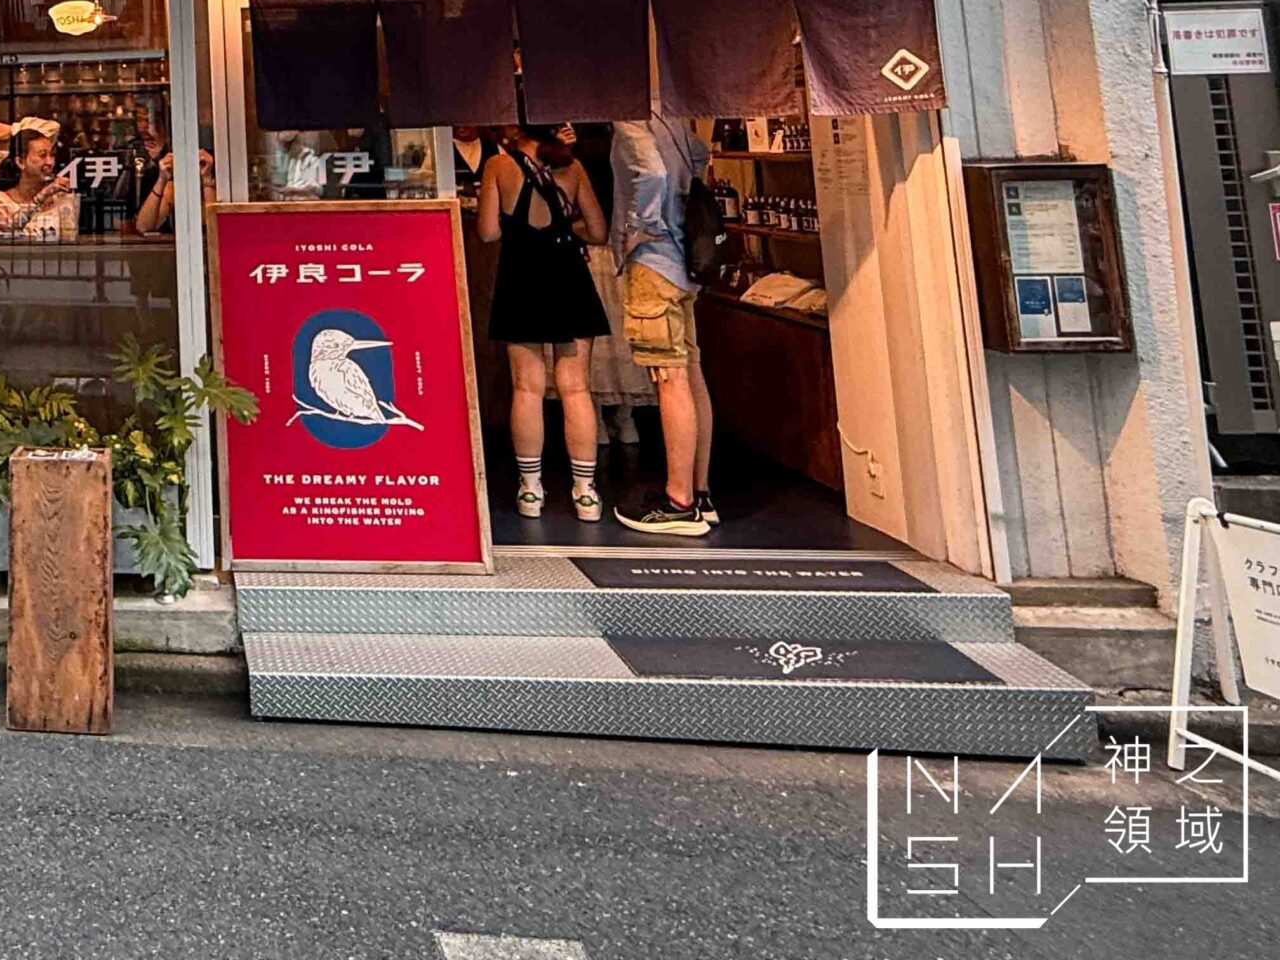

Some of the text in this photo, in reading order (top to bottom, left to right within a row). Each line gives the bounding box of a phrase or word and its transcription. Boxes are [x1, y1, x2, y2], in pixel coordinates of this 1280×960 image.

[56, 156, 123, 189] 伊
[295, 243, 374, 252] IYOSHI COLA
[249, 262, 426, 284] 伊良コーラ
[263, 474, 440, 486] THE DREAMY FLAVOR
[294, 497, 413, 506] WE BREAK THE MOLD
[282, 507, 425, 516] AS A KINGFISHER DIVING
[307, 517, 402, 526] INTO THE WATER
